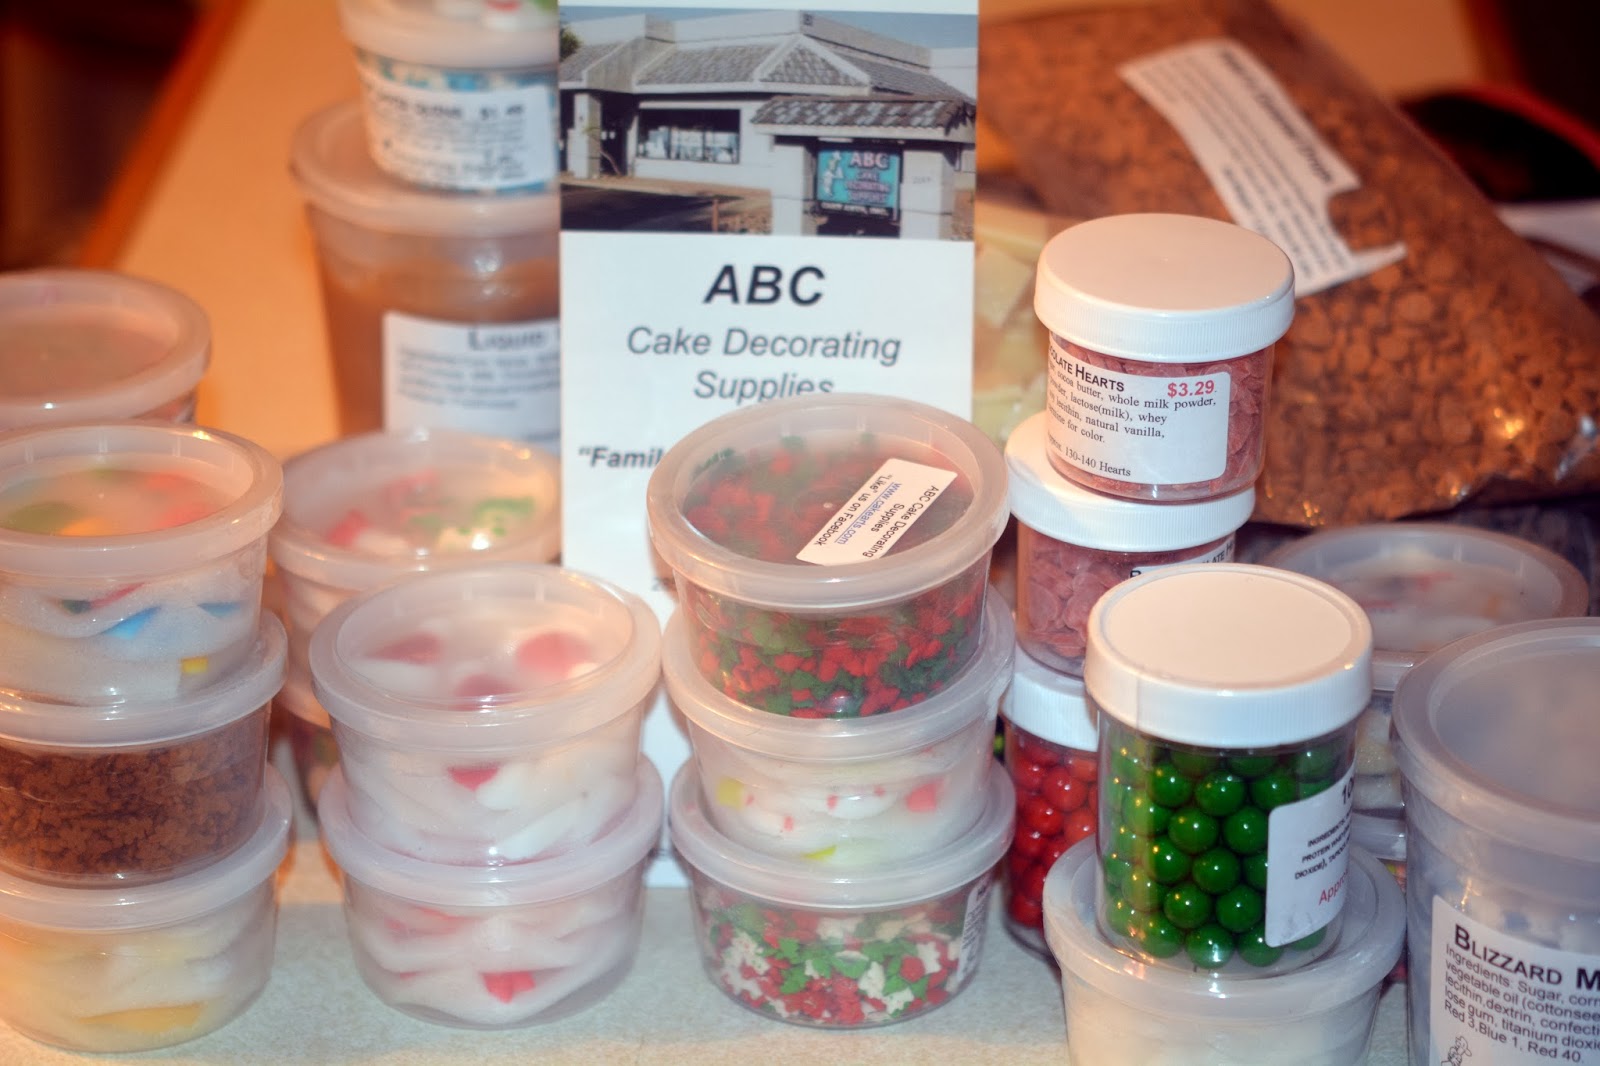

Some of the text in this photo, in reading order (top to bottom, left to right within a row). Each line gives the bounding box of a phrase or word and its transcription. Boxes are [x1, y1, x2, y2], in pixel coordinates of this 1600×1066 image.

[849, 151, 889, 170] ABC
[702, 264, 826, 307] ABC
[627, 326, 902, 367] Cake Decorating
[693, 370, 834, 403] Supplies
[1076, 380, 1105, 402] butter,
[1108, 393, 1140, 408] whole
[1144, 398, 1169, 409] milk
[1174, 397, 1217, 411] powder,
[1167, 379, 1216, 399] $3.29
[1067, 419, 1078, 433] for
[1080, 426, 1106, 444] color.
[1085, 415, 1119, 432] natural
[1124, 425, 1165, 440] vanilla,
[1138, 411, 1168, 426] whey
[1065, 446, 1097, 469] 130-140
[1099, 460, 1131, 477] Hearts
[847, 502, 861, 513] on
[858, 492, 871, 503] us
[834, 482, 903, 545] www.cakearts.com
[862, 485, 940, 559] ABC Cake Decorating
[870, 503, 905, 533] Supplies
[814, 512, 854, 547] Facebook
[1455, 923, 1562, 985] BLIZZARD
[1445, 959, 1501, 998] vegetable
[1503, 991, 1519, 1006] oil
[1517, 980, 1565, 1005] Sugar,
[1444, 999, 1465, 1024] Red
[1527, 1040, 1558, 1060] Red
[1445, 985, 1466, 1010] lose
[1467, 1003, 1499, 1029] gum,
[1501, 1018, 1558, 1046] titanium
